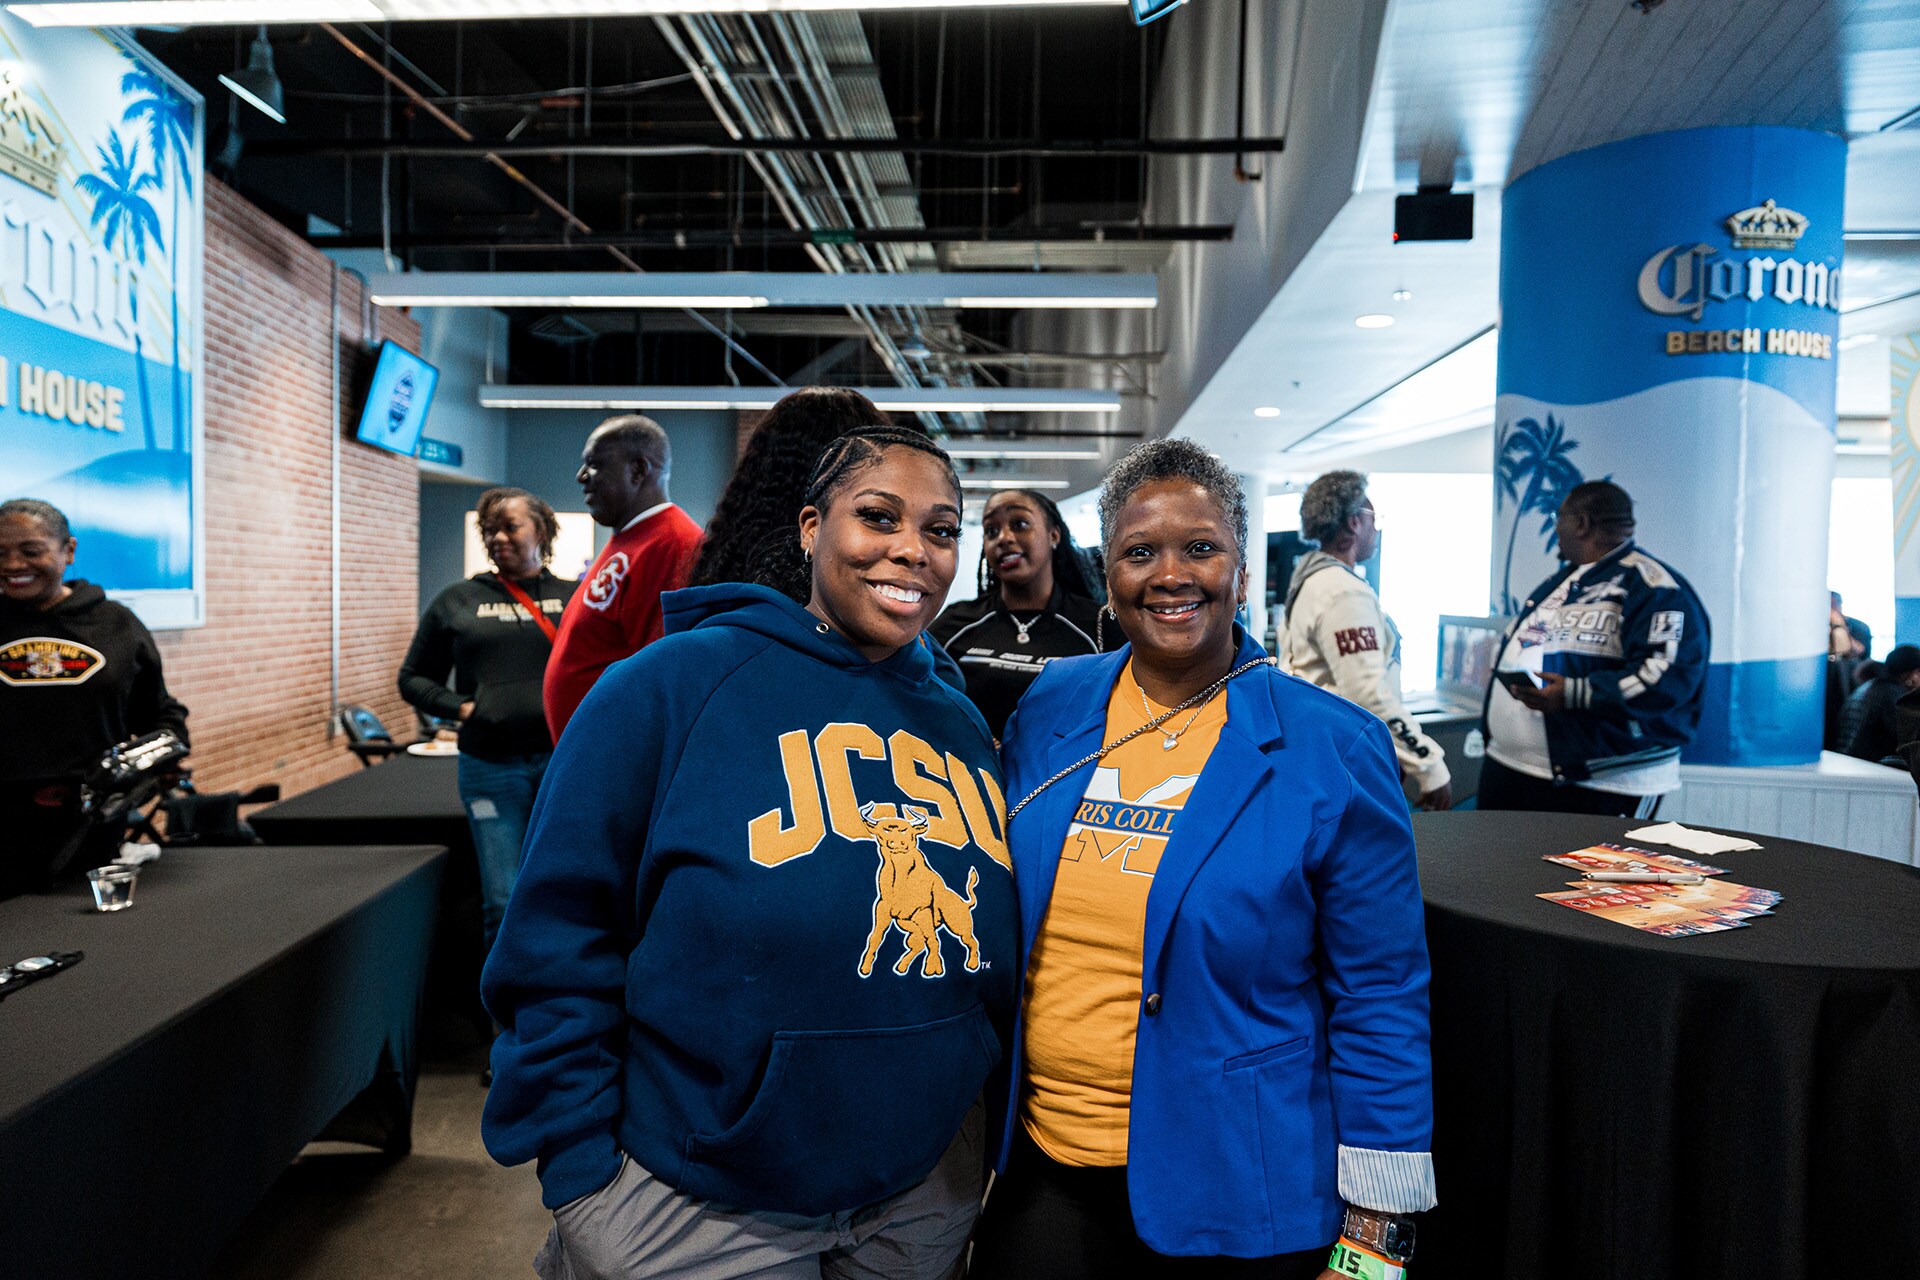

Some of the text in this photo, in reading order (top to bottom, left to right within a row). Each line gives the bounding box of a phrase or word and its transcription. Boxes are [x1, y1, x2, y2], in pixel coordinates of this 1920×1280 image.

[1667, 328, 1832, 360] BEACH HOUSE
[18, 362, 125, 433] HOUSE
[748, 722, 1013, 869] JCSU
[1114, 807, 1176, 834] COLL
[981, 960, 992, 970] TM
